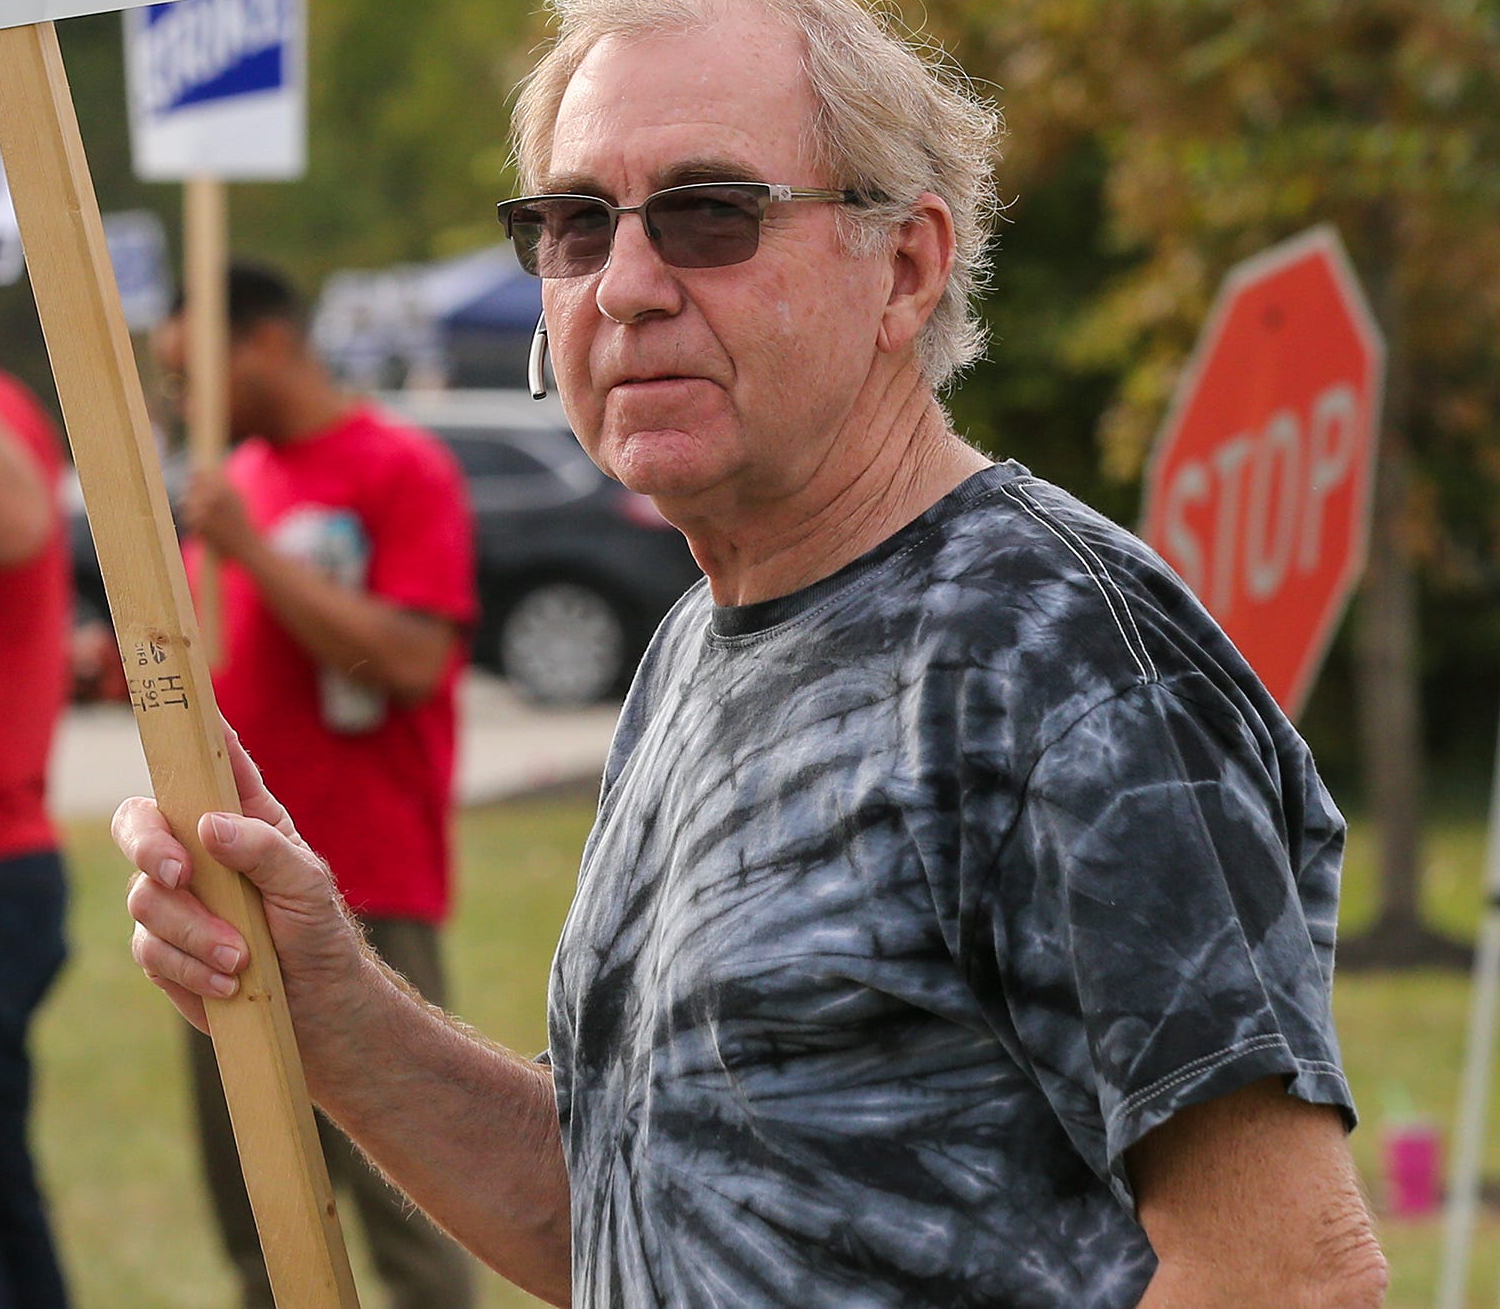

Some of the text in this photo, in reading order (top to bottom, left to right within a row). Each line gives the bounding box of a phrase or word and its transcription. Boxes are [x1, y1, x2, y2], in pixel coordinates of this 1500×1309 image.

[1165, 380, 1357, 618] STOP
[142, 679, 160, 708] 591
[158, 675, 188, 709] HT
